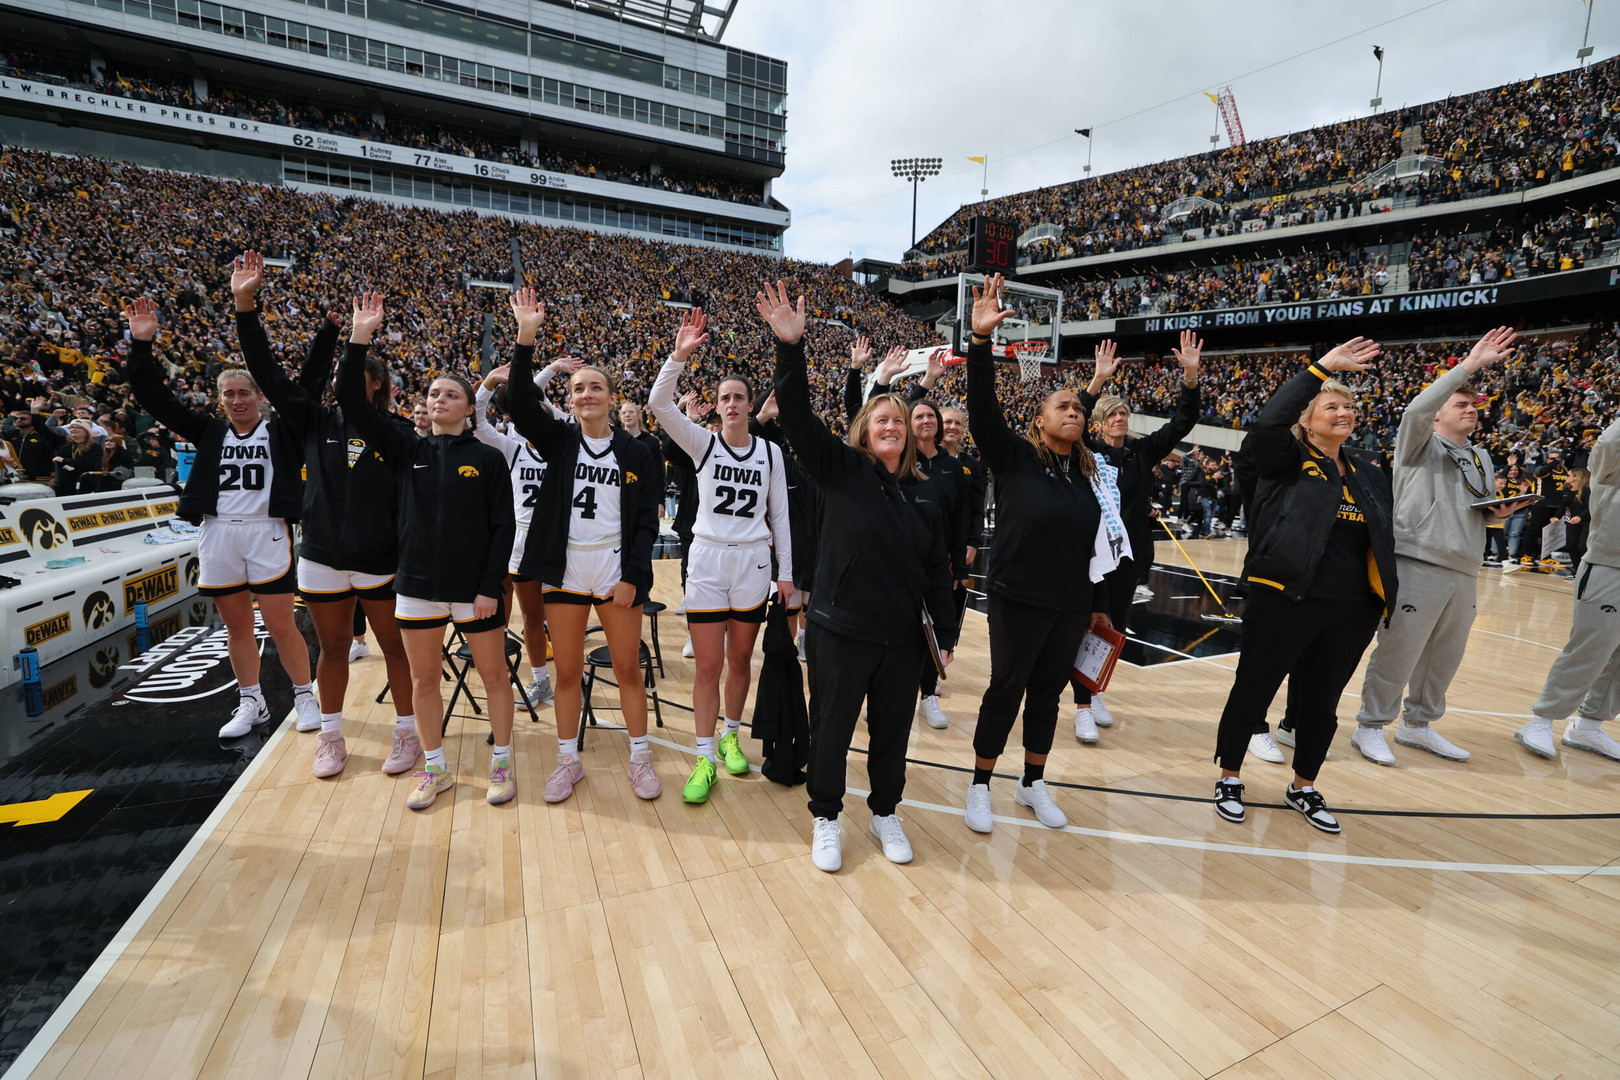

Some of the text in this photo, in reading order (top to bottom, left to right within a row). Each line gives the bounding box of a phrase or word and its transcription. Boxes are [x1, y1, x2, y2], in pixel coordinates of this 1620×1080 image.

[47, 89, 147, 113] BRECHLER
[161, 110, 216, 125] PRESS
[229, 121, 260, 133] BOX
[292, 133, 314, 148] 62
[316, 137, 338, 147] Calvin
[316, 143, 338, 152] Jones
[360, 145, 367, 157] 1
[369, 146, 392, 156] Aubrey
[369, 152, 391, 161] Devine
[413, 153, 431, 167] 77
[434, 156, 448, 164] Alex
[434, 162, 454, 171] Karras
[473, 163, 489, 176] 16
[491, 166, 510, 175] Chuck
[491, 171, 506, 180] Long
[530, 173, 547, 185] 99
[985, 238, 1008, 266] 30
[1145, 319, 1161, 332] HI
[1163, 314, 1203, 331] KIDS!
[1215, 311, 1259, 326] FROM
[1264, 306, 1312, 323] YOUR
[1316, 301, 1364, 319] FANS
[1368, 298, 1392, 315] AT
[1399, 289, 1498, 312] KINNICK!
[220, 445, 269, 460] OWA
[219, 464, 264, 491] 20
[574, 462, 621, 487] OWA
[713, 463, 762, 487] IOWA
[522, 484, 541, 508] 2
[573, 486, 598, 520] 4
[713, 485, 758, 519] 22
[69, 515, 98, 530] DEWALT
[125, 569, 177, 607] DEWALT
[27, 616, 70, 646] DEWALT
